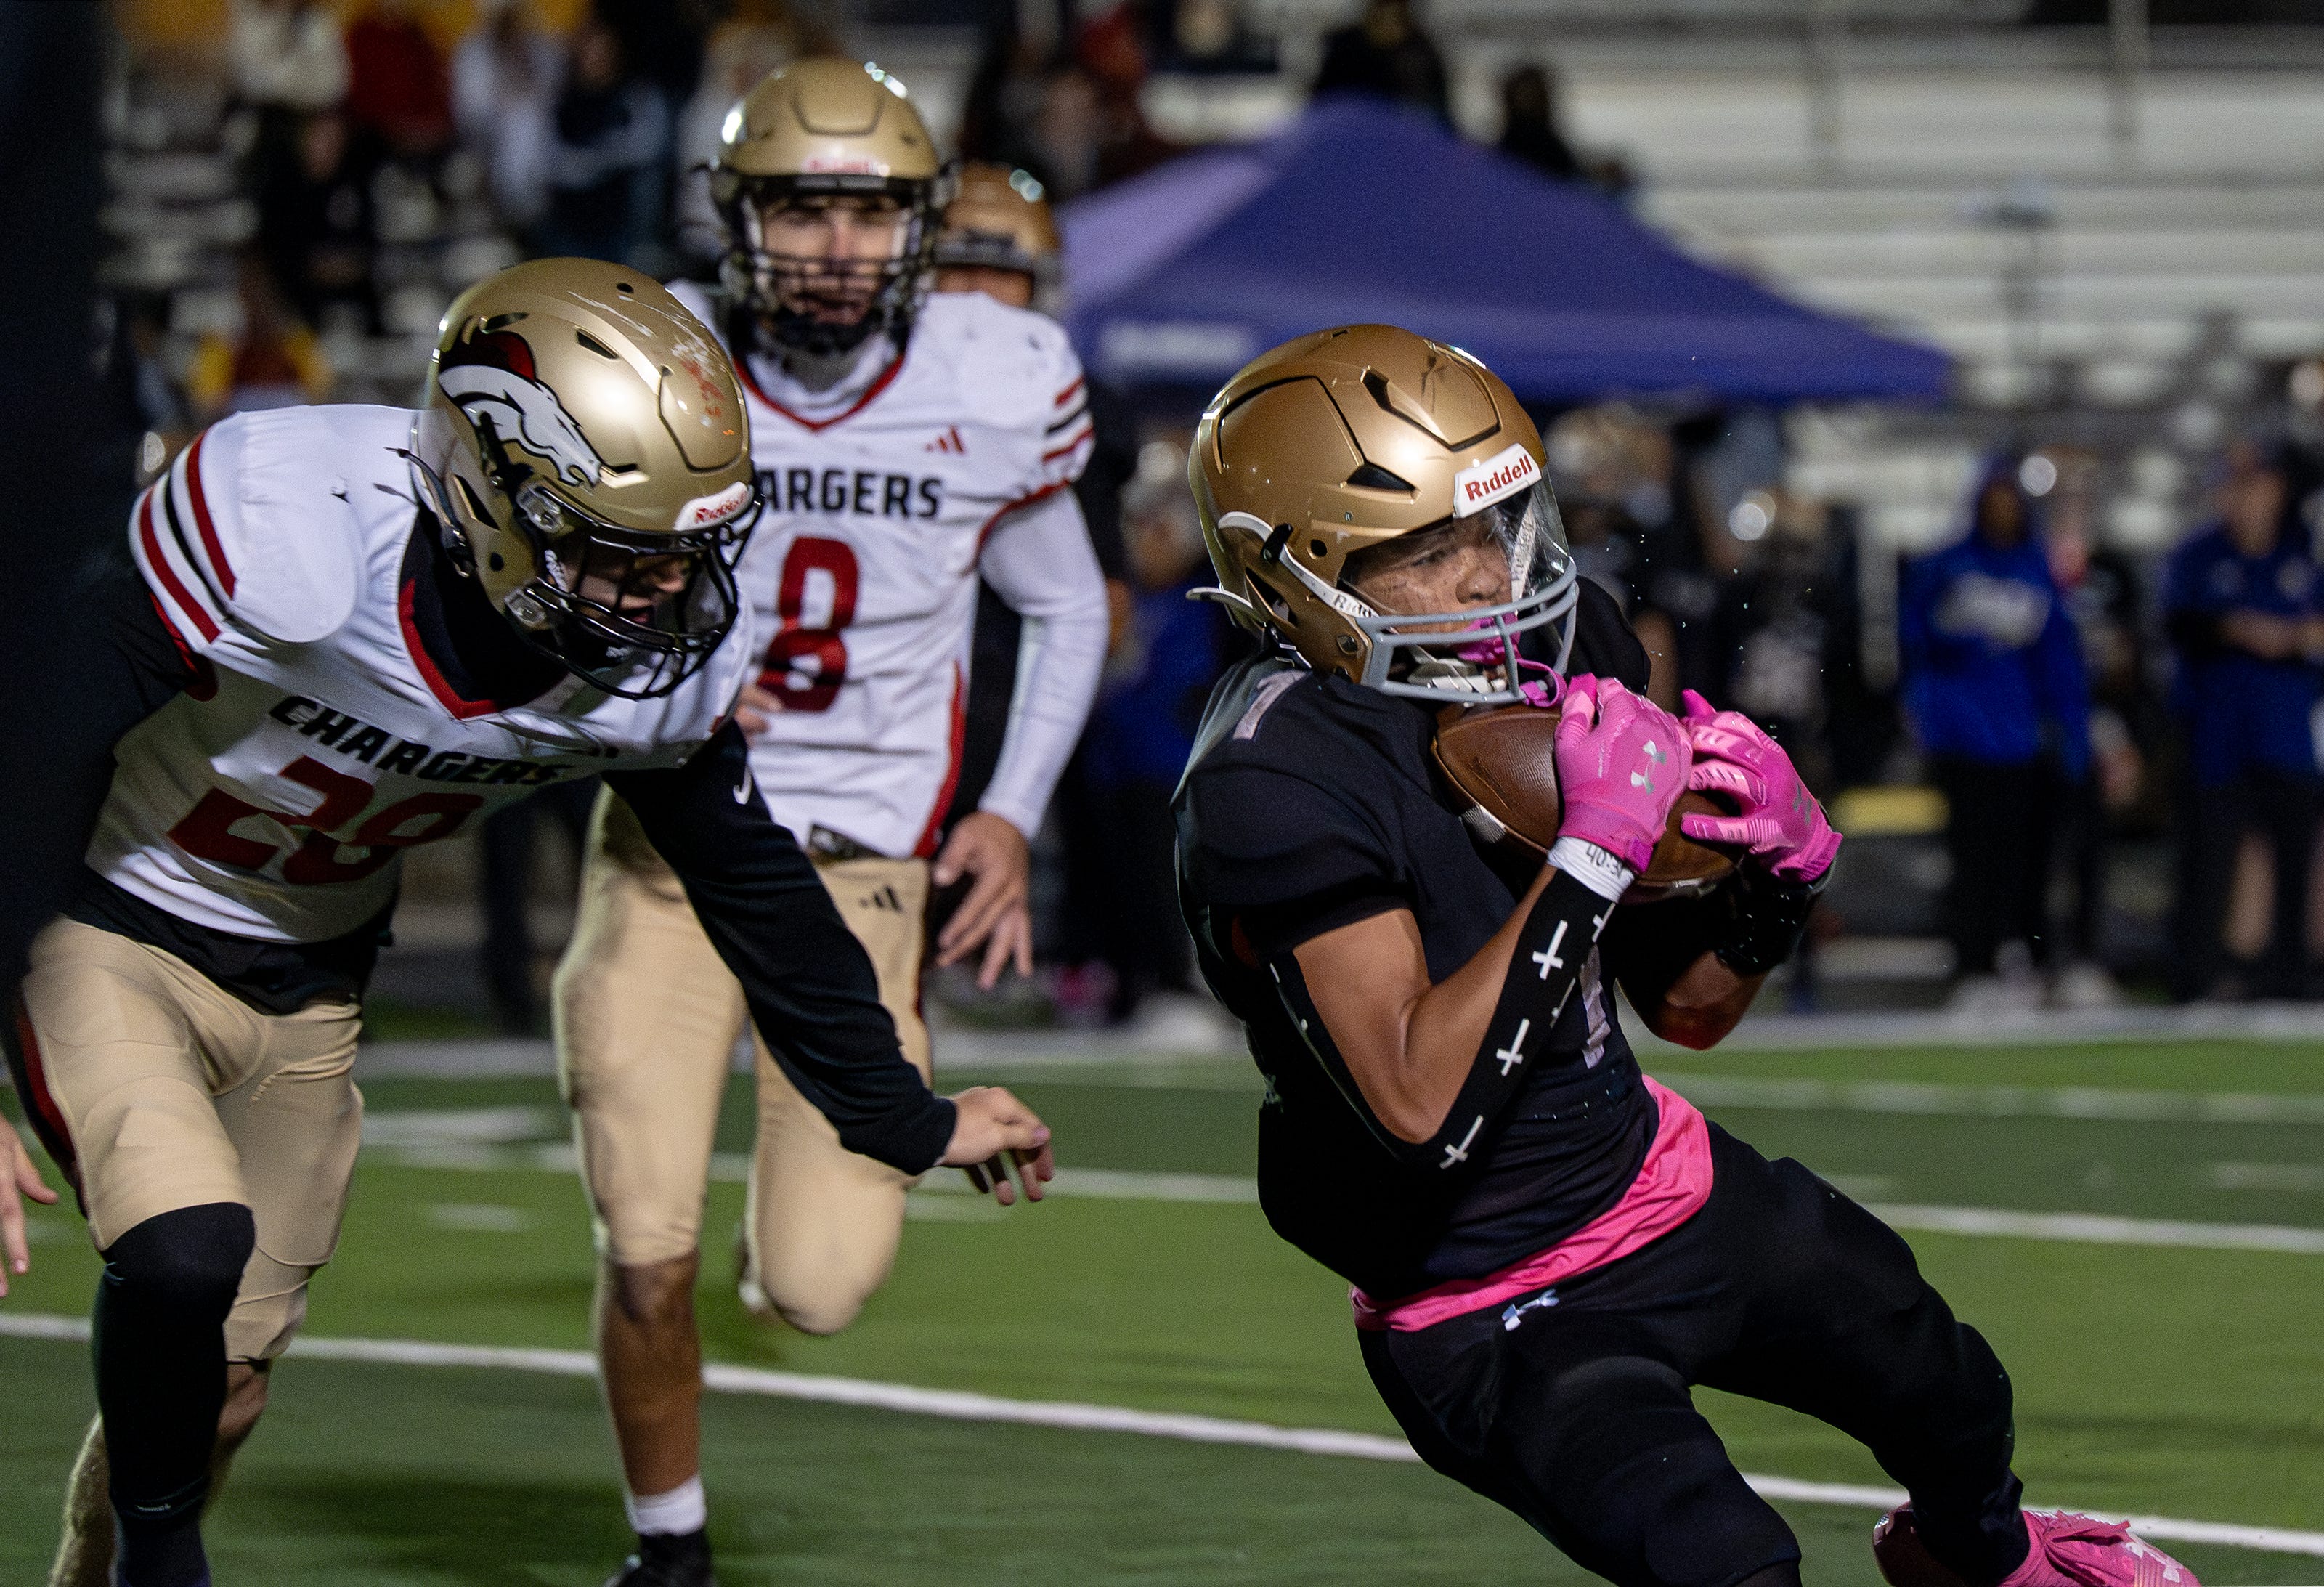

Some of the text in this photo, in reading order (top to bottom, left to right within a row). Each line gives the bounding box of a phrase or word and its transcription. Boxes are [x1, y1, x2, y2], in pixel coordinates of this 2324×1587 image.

[757, 468, 943, 519] ARGERS
[1464, 454, 1532, 502] Riddell
[757, 537, 859, 713] 8
[269, 695, 576, 785] CHARGERS
[167, 755, 484, 884] 28
